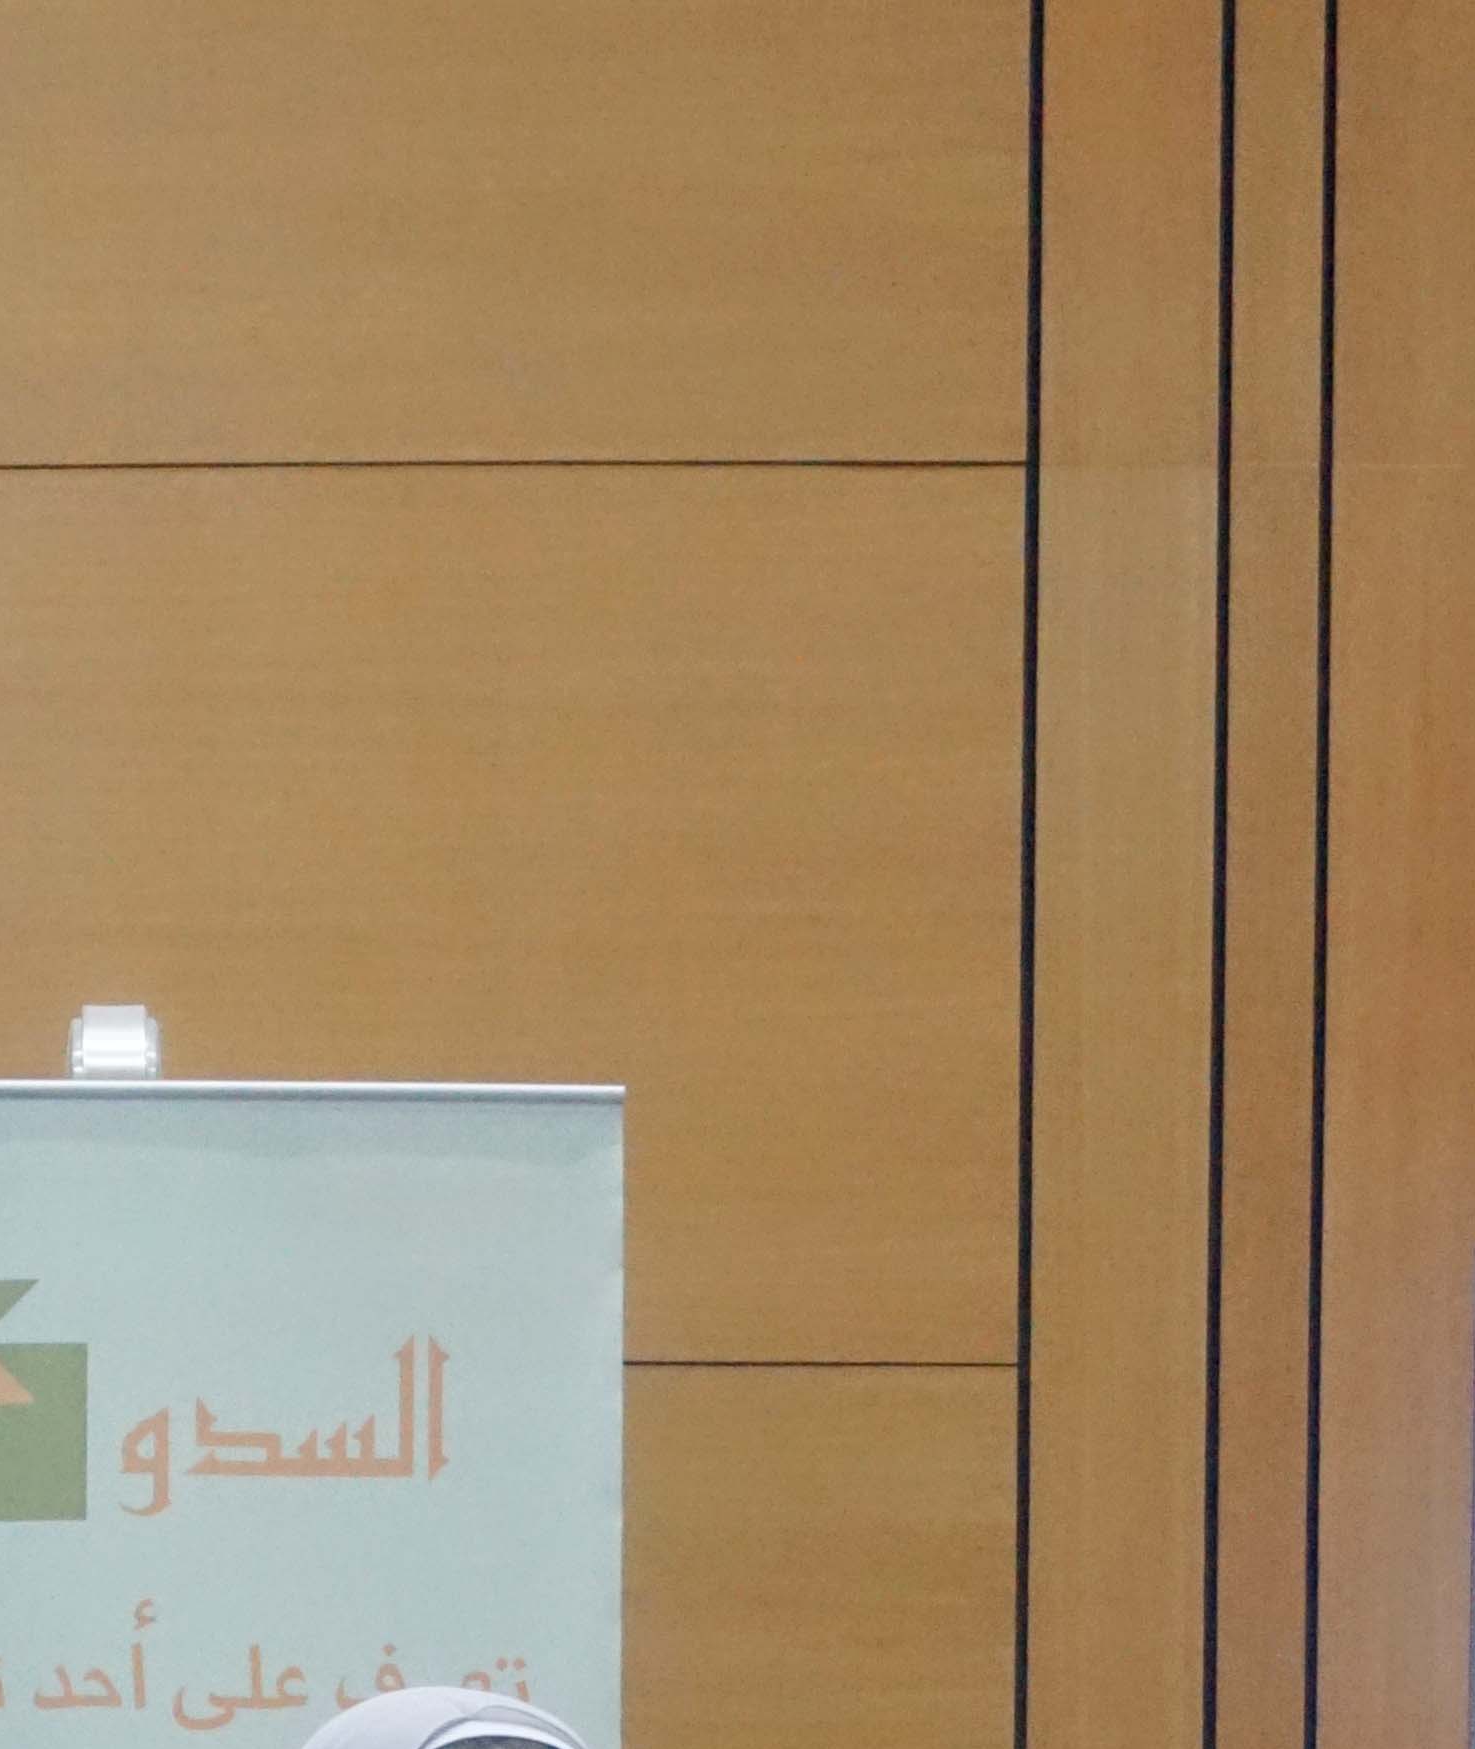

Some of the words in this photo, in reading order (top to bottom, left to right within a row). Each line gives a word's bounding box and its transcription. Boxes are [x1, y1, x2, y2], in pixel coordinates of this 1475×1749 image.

[118, 1333, 453, 1517] السدو
[34, 1600, 159, 1712] أحد
[171, 1642, 309, 1732] على
